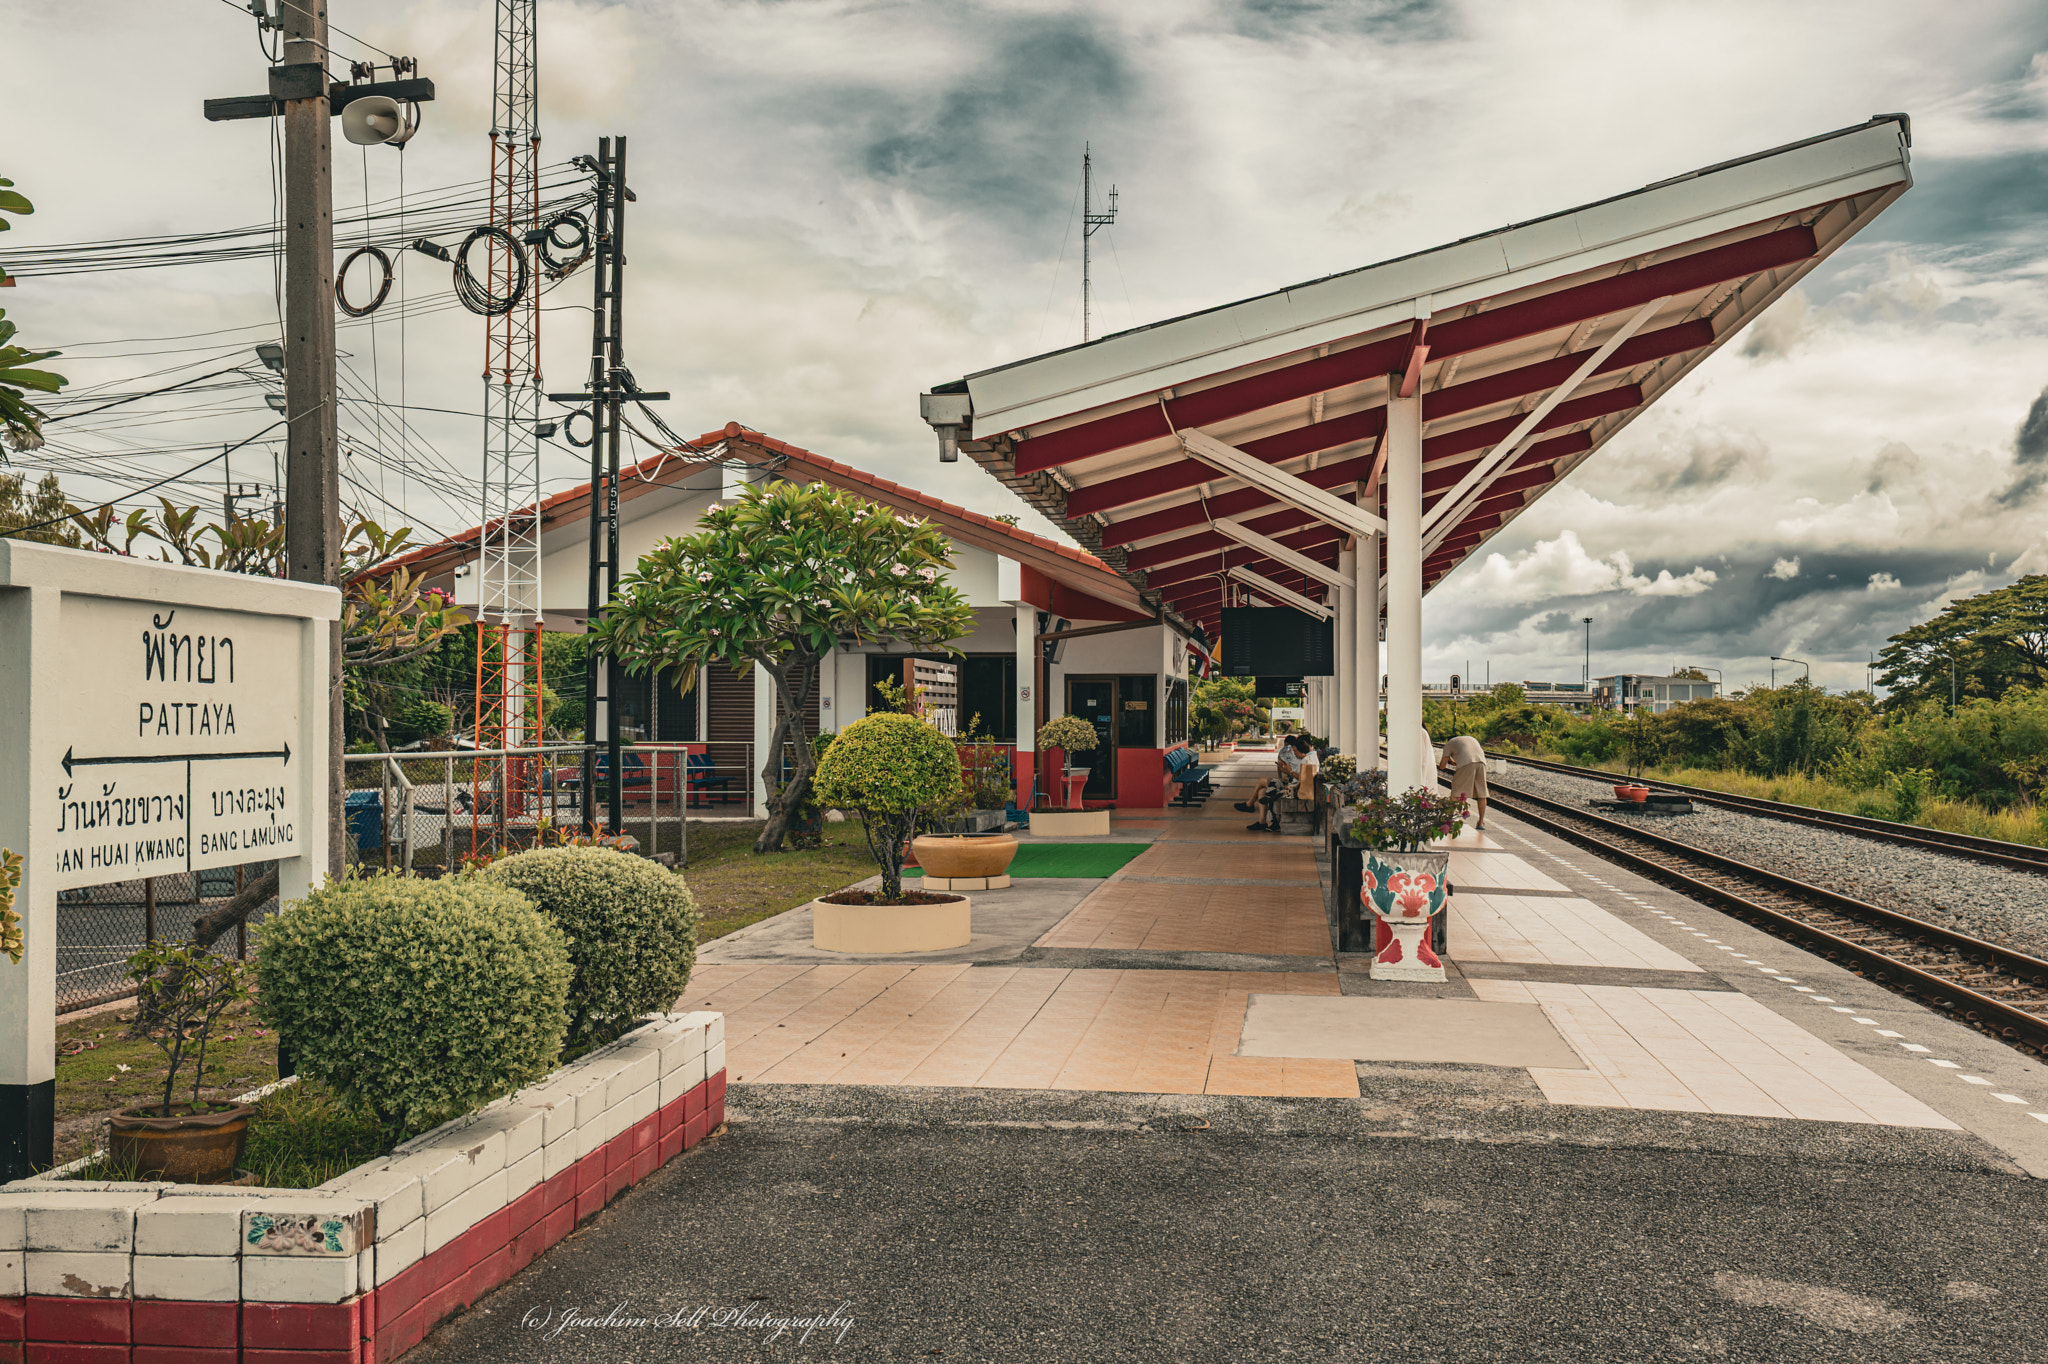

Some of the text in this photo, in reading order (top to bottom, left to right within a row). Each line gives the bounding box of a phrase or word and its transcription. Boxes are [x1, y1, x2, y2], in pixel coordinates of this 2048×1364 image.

[142, 609, 234, 685] พัทยา
[139, 702, 236, 738] PATTAYA
[925, 707, 958, 738] TTAYA
[211, 785, 285, 826] บางละมุง
[56, 836, 185, 873] AN HUAI KWANG
[201, 823, 293, 855] BANG LAMUNG
